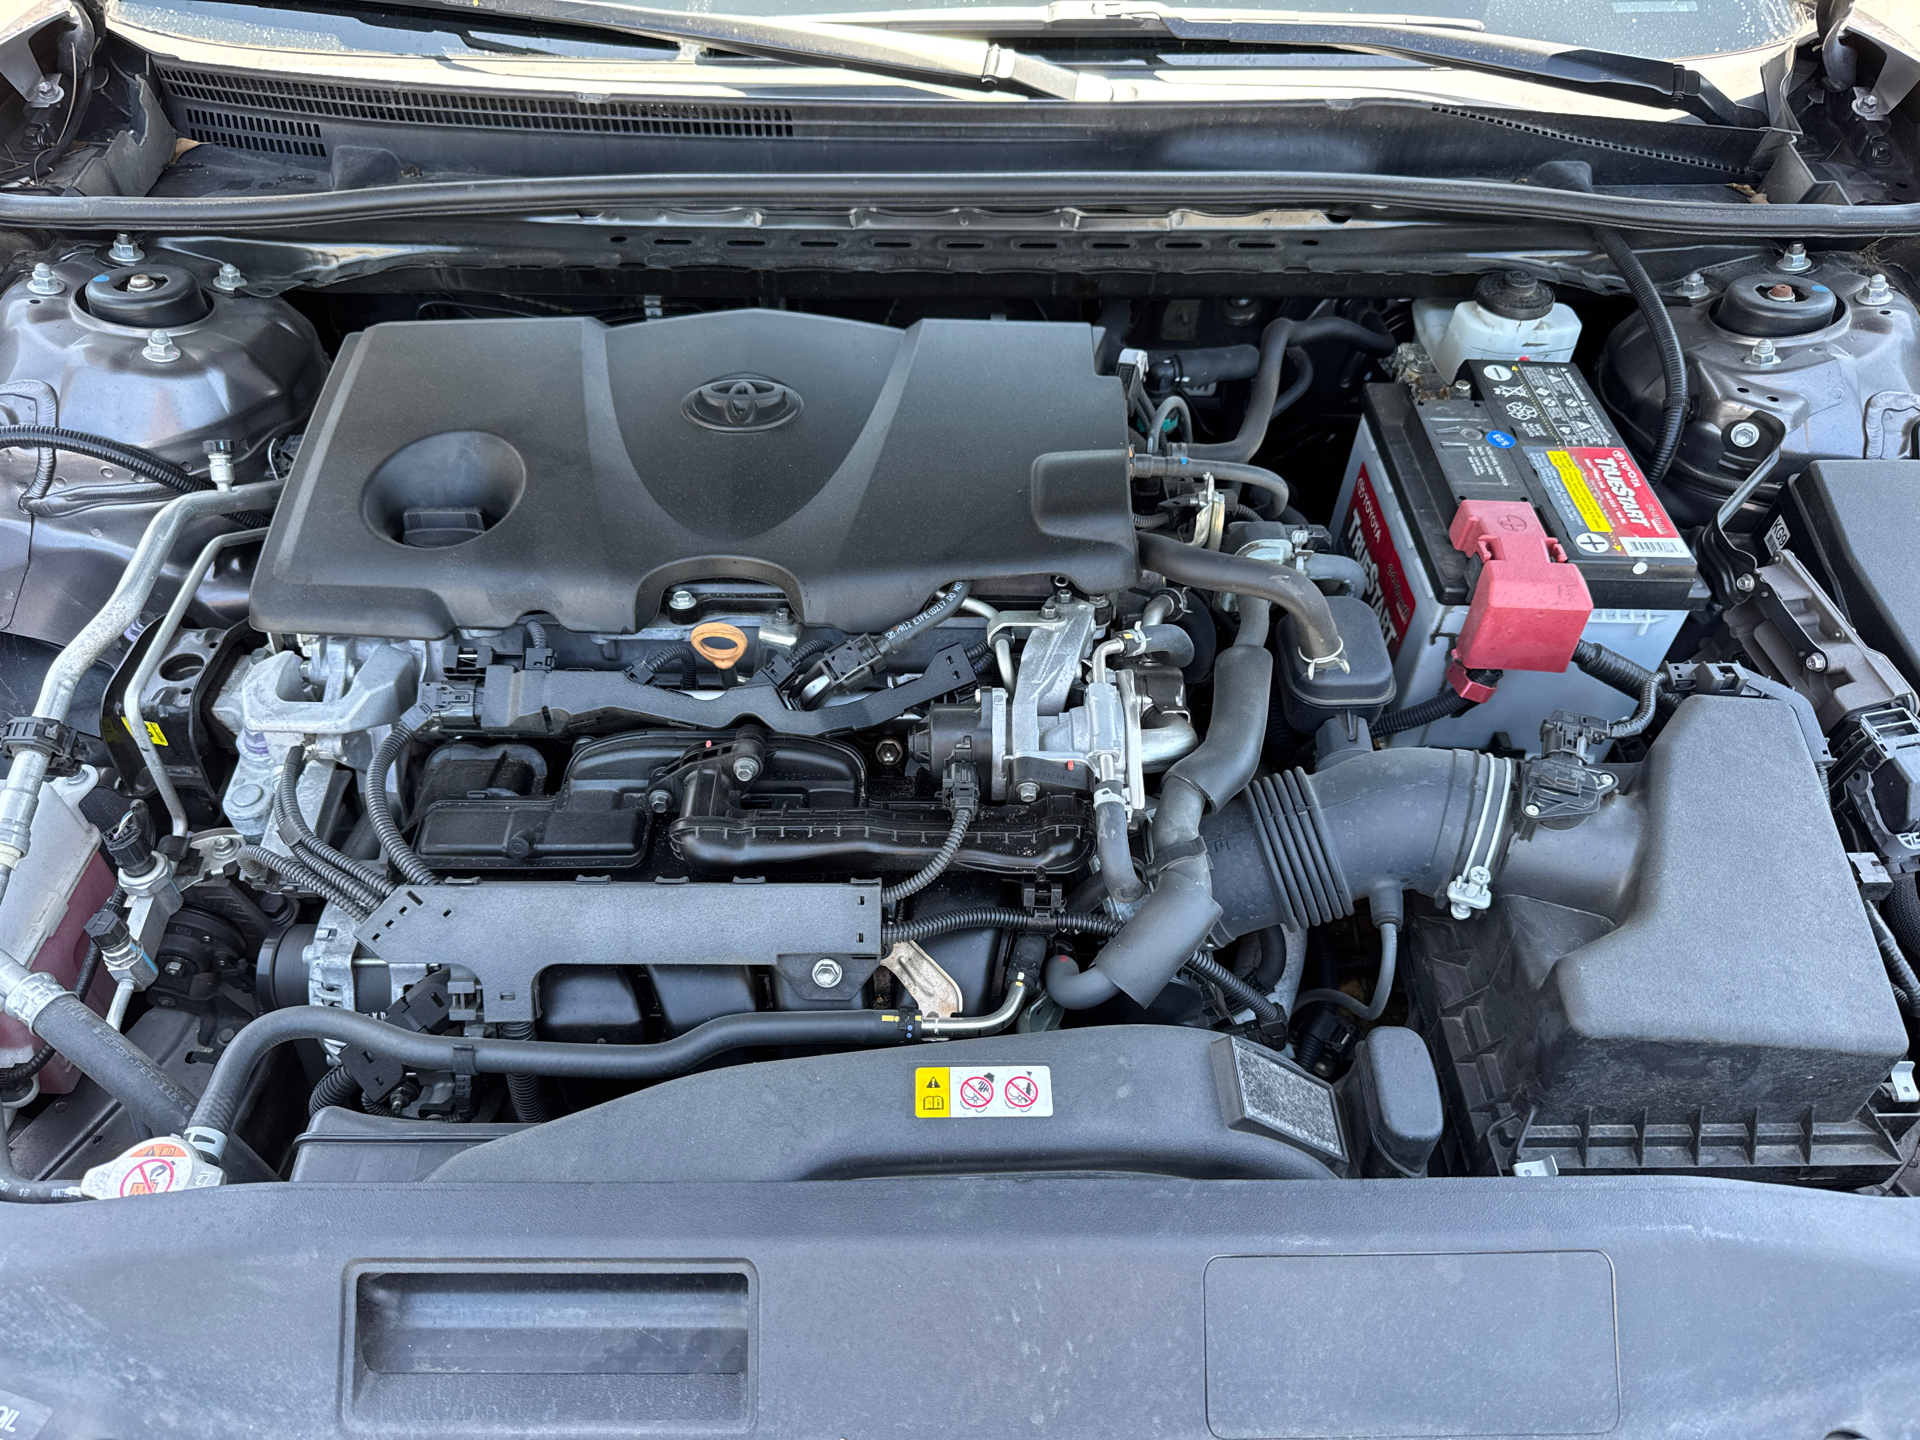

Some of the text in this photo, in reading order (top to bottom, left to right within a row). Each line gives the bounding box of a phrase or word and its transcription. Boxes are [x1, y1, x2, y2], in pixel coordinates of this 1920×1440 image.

[1619, 461, 1641, 487] TOYOTA
[1362, 491, 1381, 543] TOYOTA
[1771, 519, 1788, 546] KG9
[946, 592, 957, 602] DO
